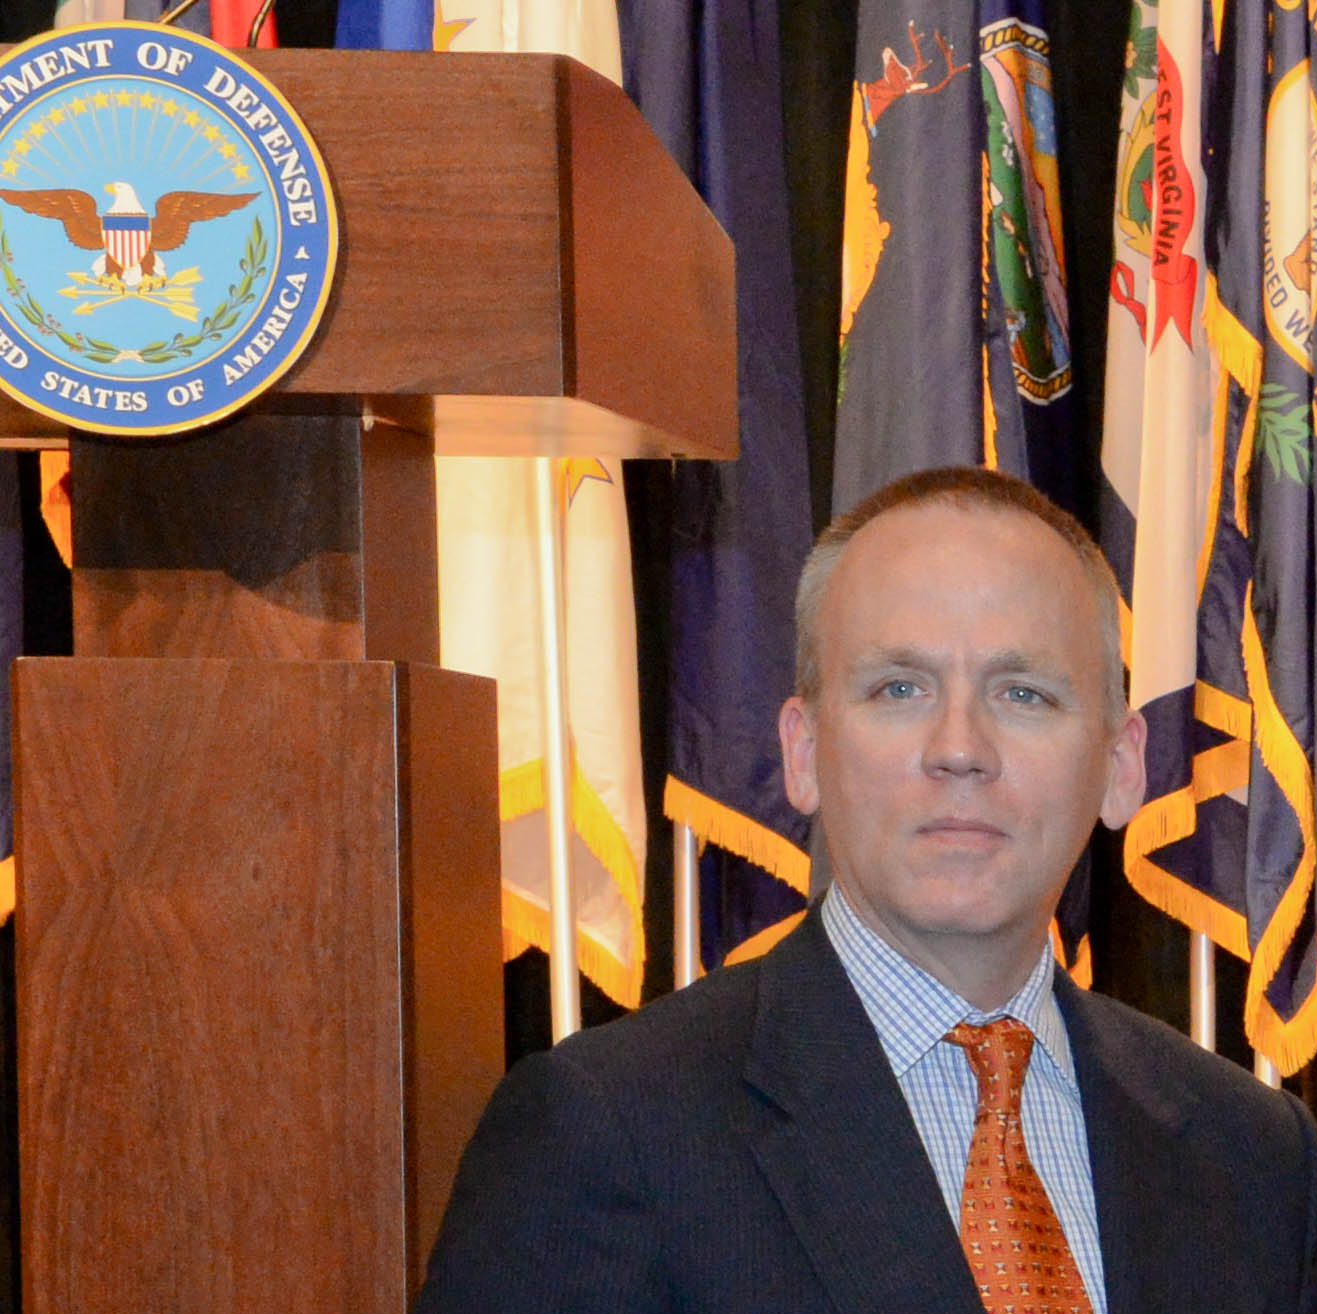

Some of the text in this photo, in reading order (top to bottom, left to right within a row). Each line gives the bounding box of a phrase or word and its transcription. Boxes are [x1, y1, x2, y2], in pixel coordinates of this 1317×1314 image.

[137, 41, 194, 77] OF
[204, 67, 317, 226] DEFENSE
[1153, 134, 1182, 266] VIRGINIA
[40, 272, 309, 412] STATES OF AMERICA
